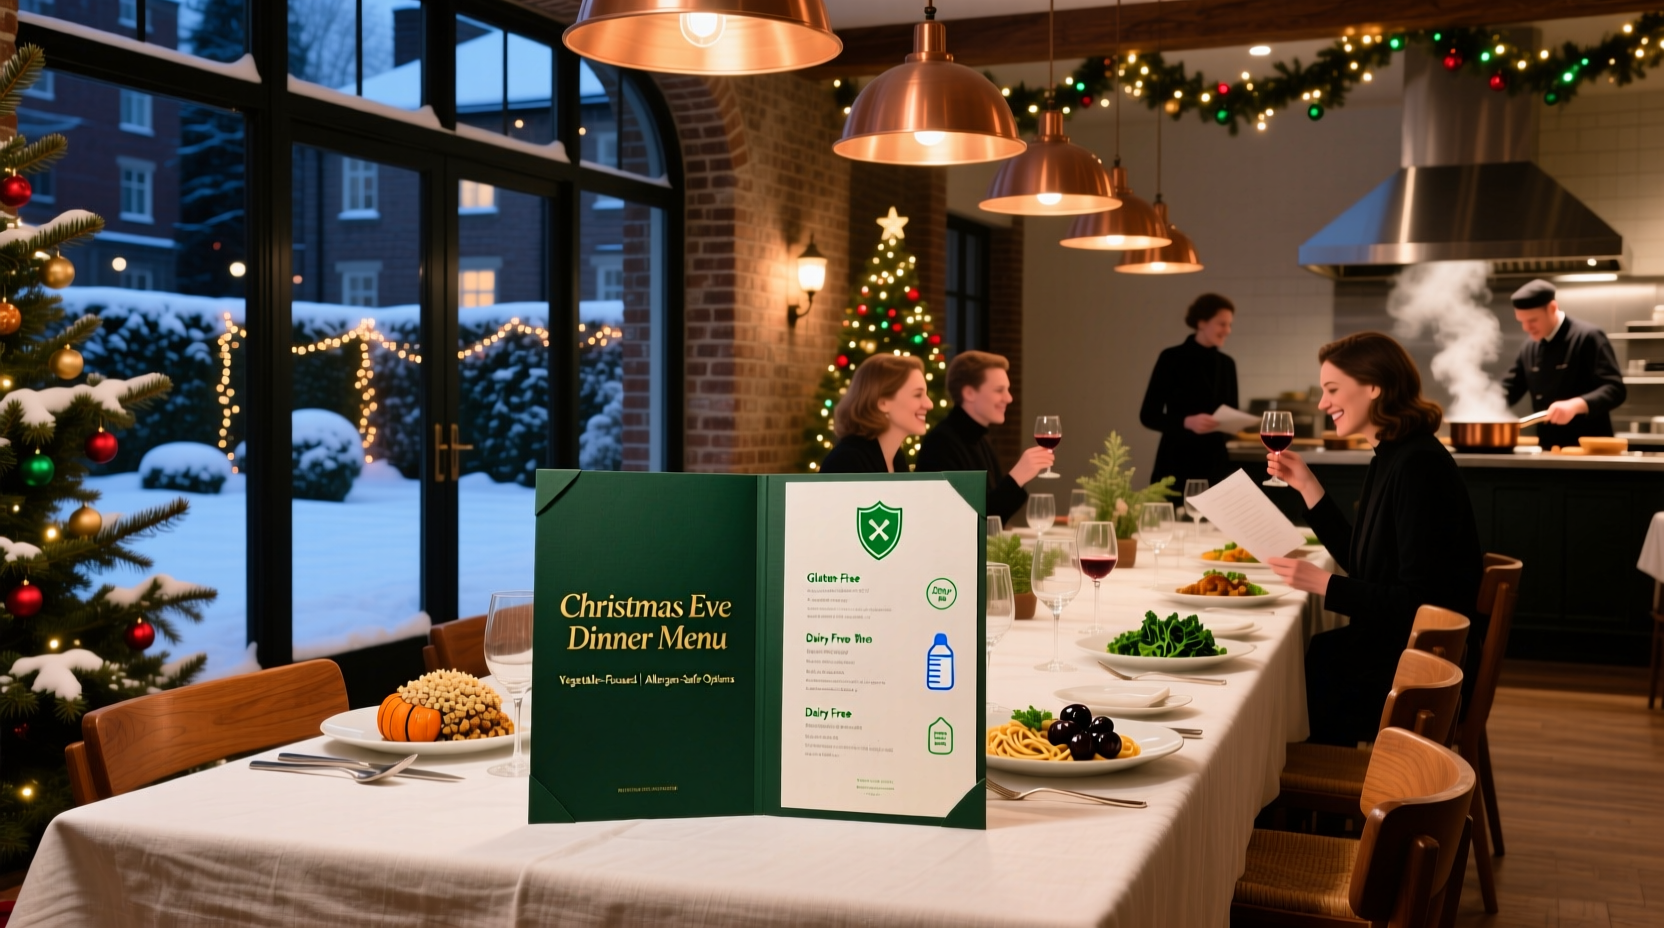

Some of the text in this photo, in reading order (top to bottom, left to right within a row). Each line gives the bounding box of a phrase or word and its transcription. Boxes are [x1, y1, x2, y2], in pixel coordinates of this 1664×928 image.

[560, 592, 732, 618] Christmas Eve
[567, 625, 728, 650] Dinner Menu
[805, 707, 829, 721] Dairy
